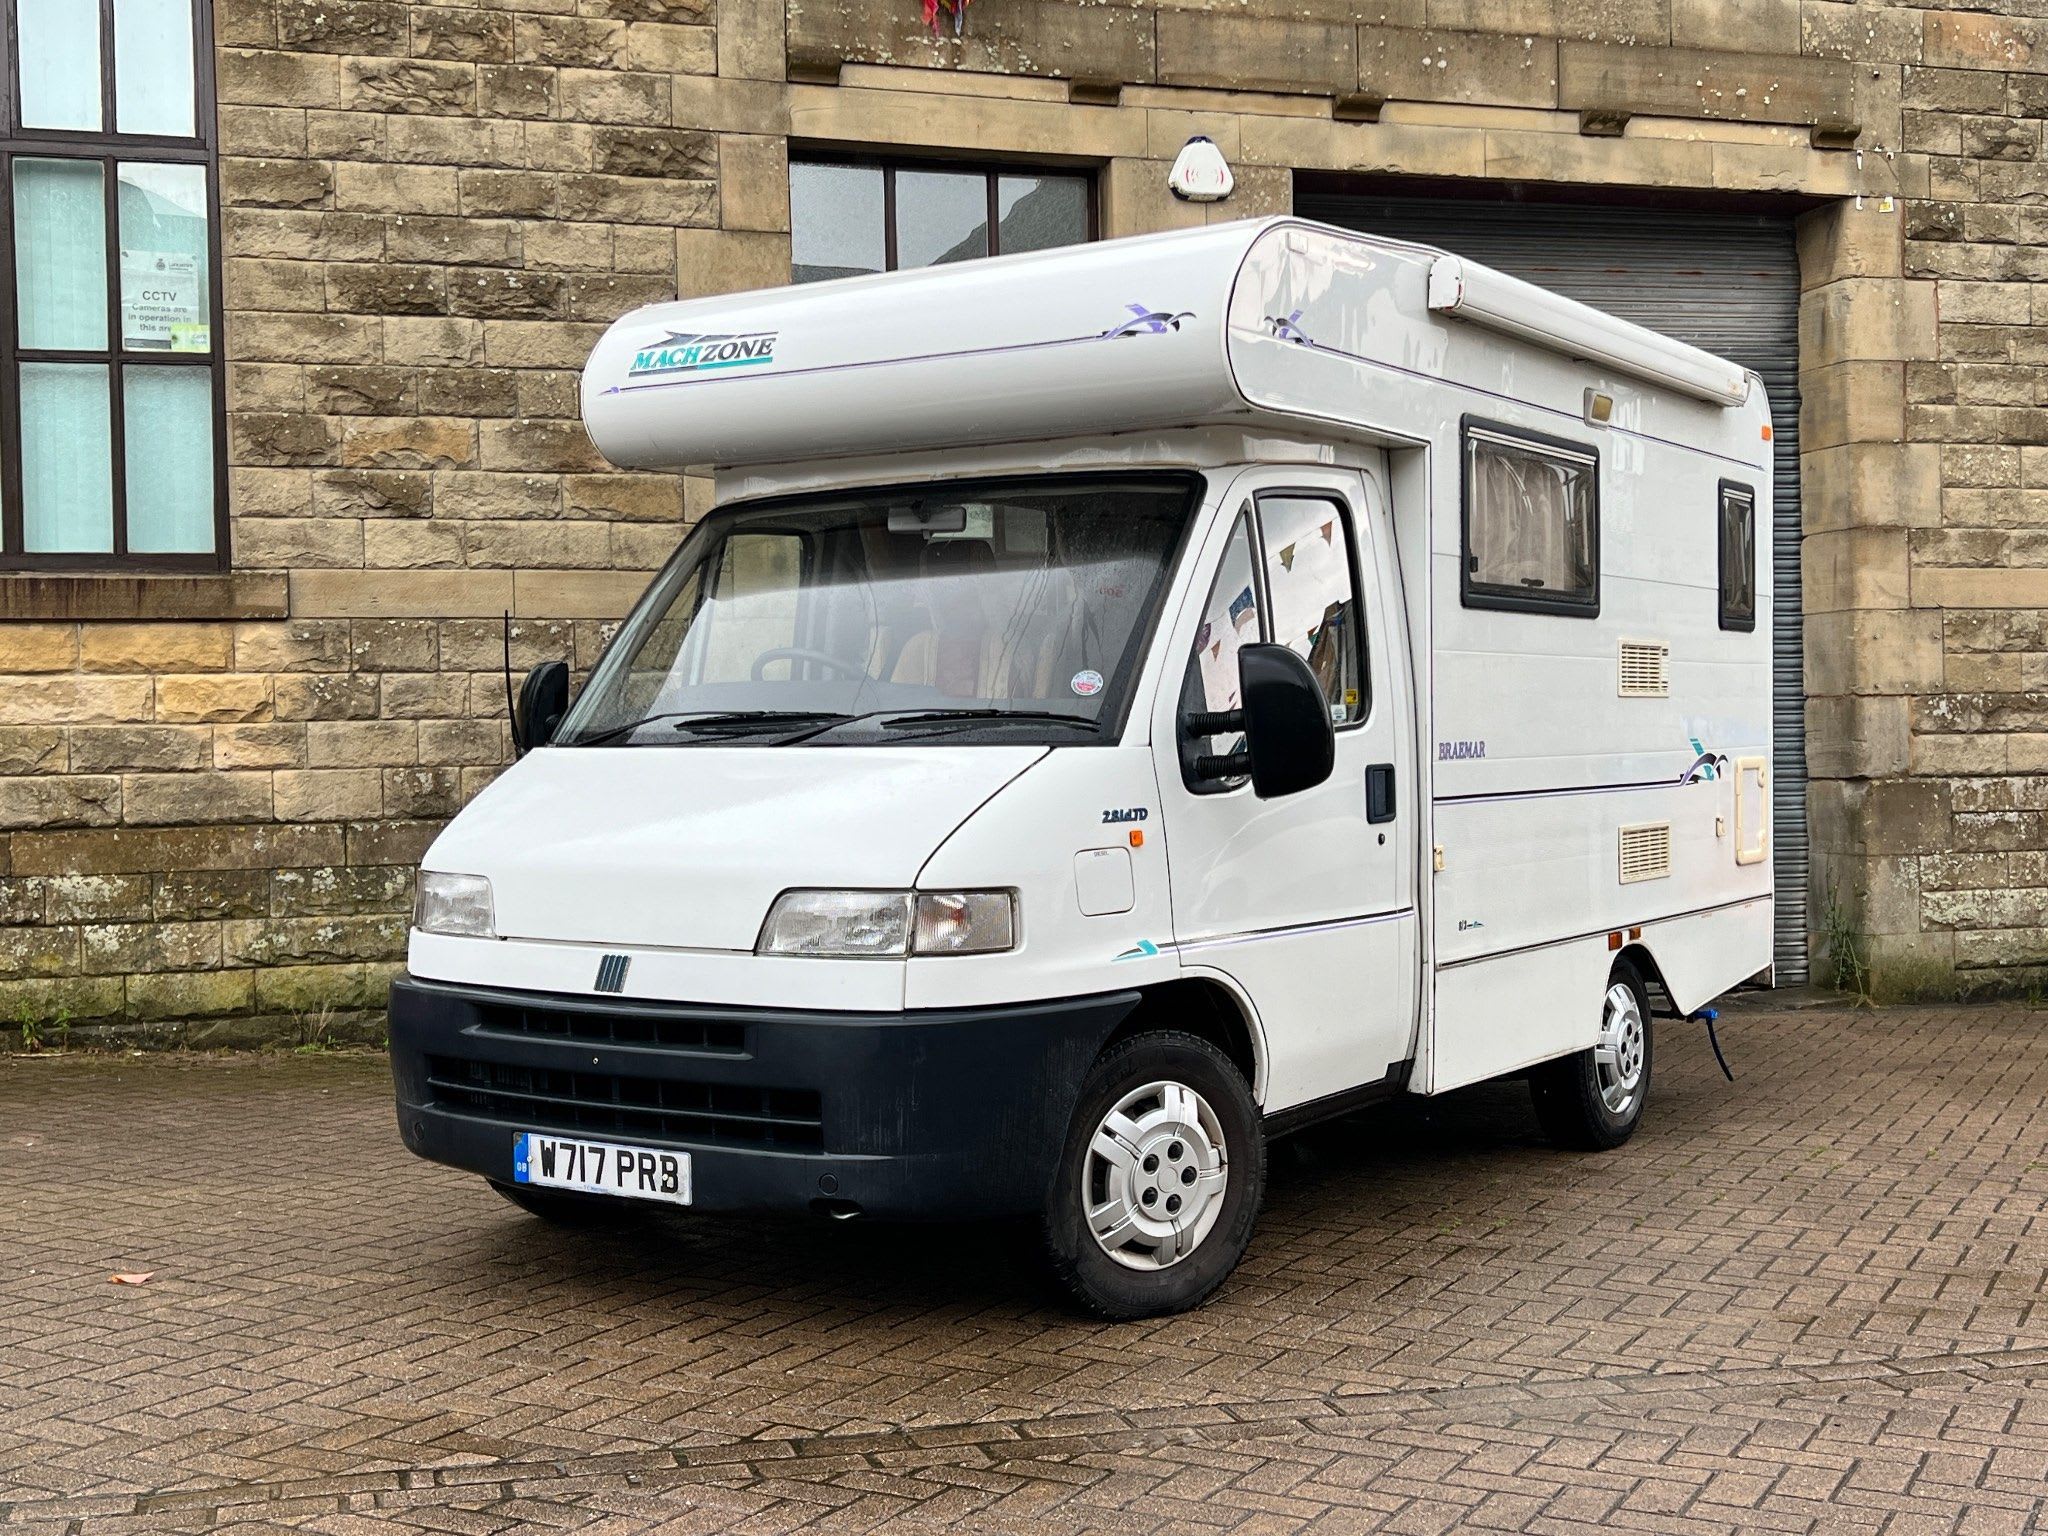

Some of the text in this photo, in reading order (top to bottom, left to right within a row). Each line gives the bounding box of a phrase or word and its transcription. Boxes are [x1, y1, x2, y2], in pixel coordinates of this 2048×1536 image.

[142, 290, 177, 301] CCTV
[132, 303, 188, 313] Cameras are
[128, 312, 137, 320] in
[139, 313, 181, 323] operation
[139, 323, 157, 332] this
[1438, 741, 1486, 760] BRAEMAR
[516, 1161, 528, 1173] GB
[539, 1139, 679, 1194] W717 PRB
